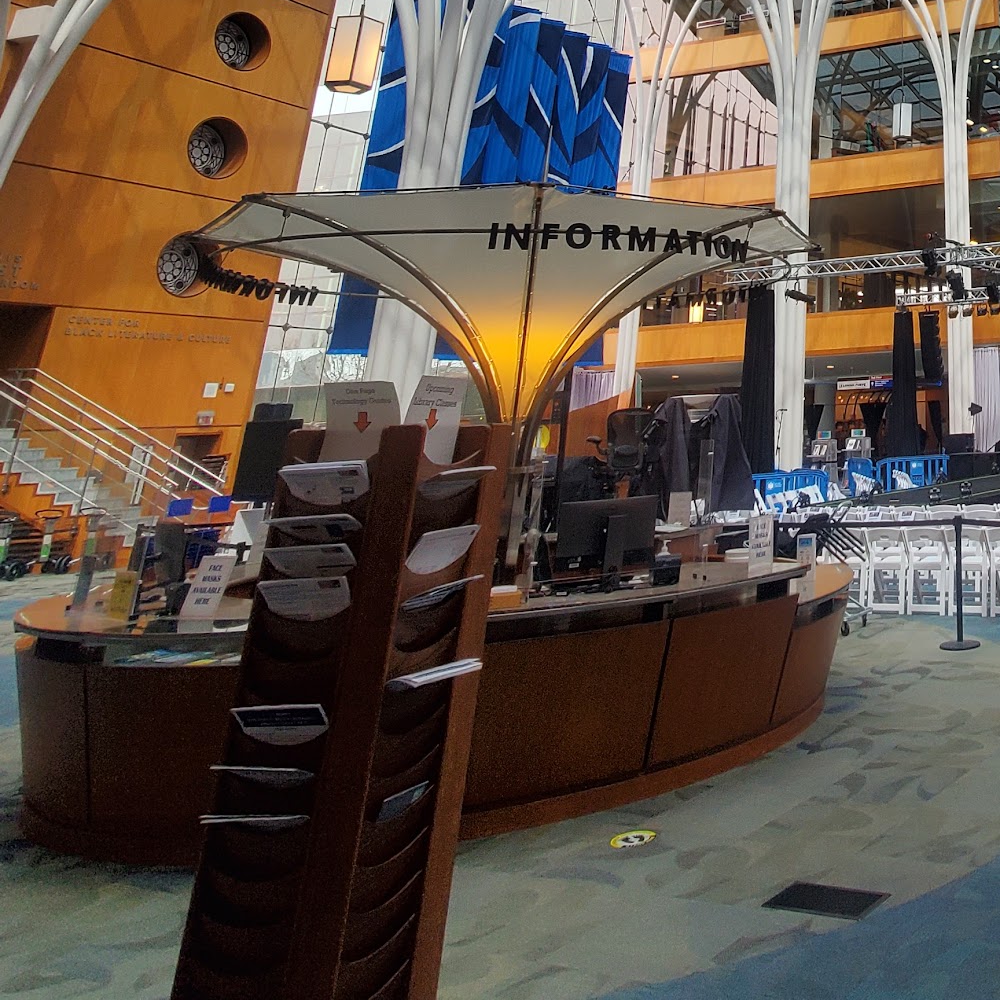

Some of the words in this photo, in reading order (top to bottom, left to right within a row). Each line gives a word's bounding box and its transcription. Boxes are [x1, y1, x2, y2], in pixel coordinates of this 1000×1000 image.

[487, 222, 750, 264] INFORMATION
[68, 315, 113, 327] CENTER
[118, 318, 141, 329] FOR
[64, 327, 104, 339] BLACK
[107, 329, 172, 342] LITERATURE
[188, 333, 232, 345] CULTURE
[208, 564, 223, 572] FACE
[202, 575, 222, 583] MASKS
[193, 586, 223, 594] AVAILABLE
